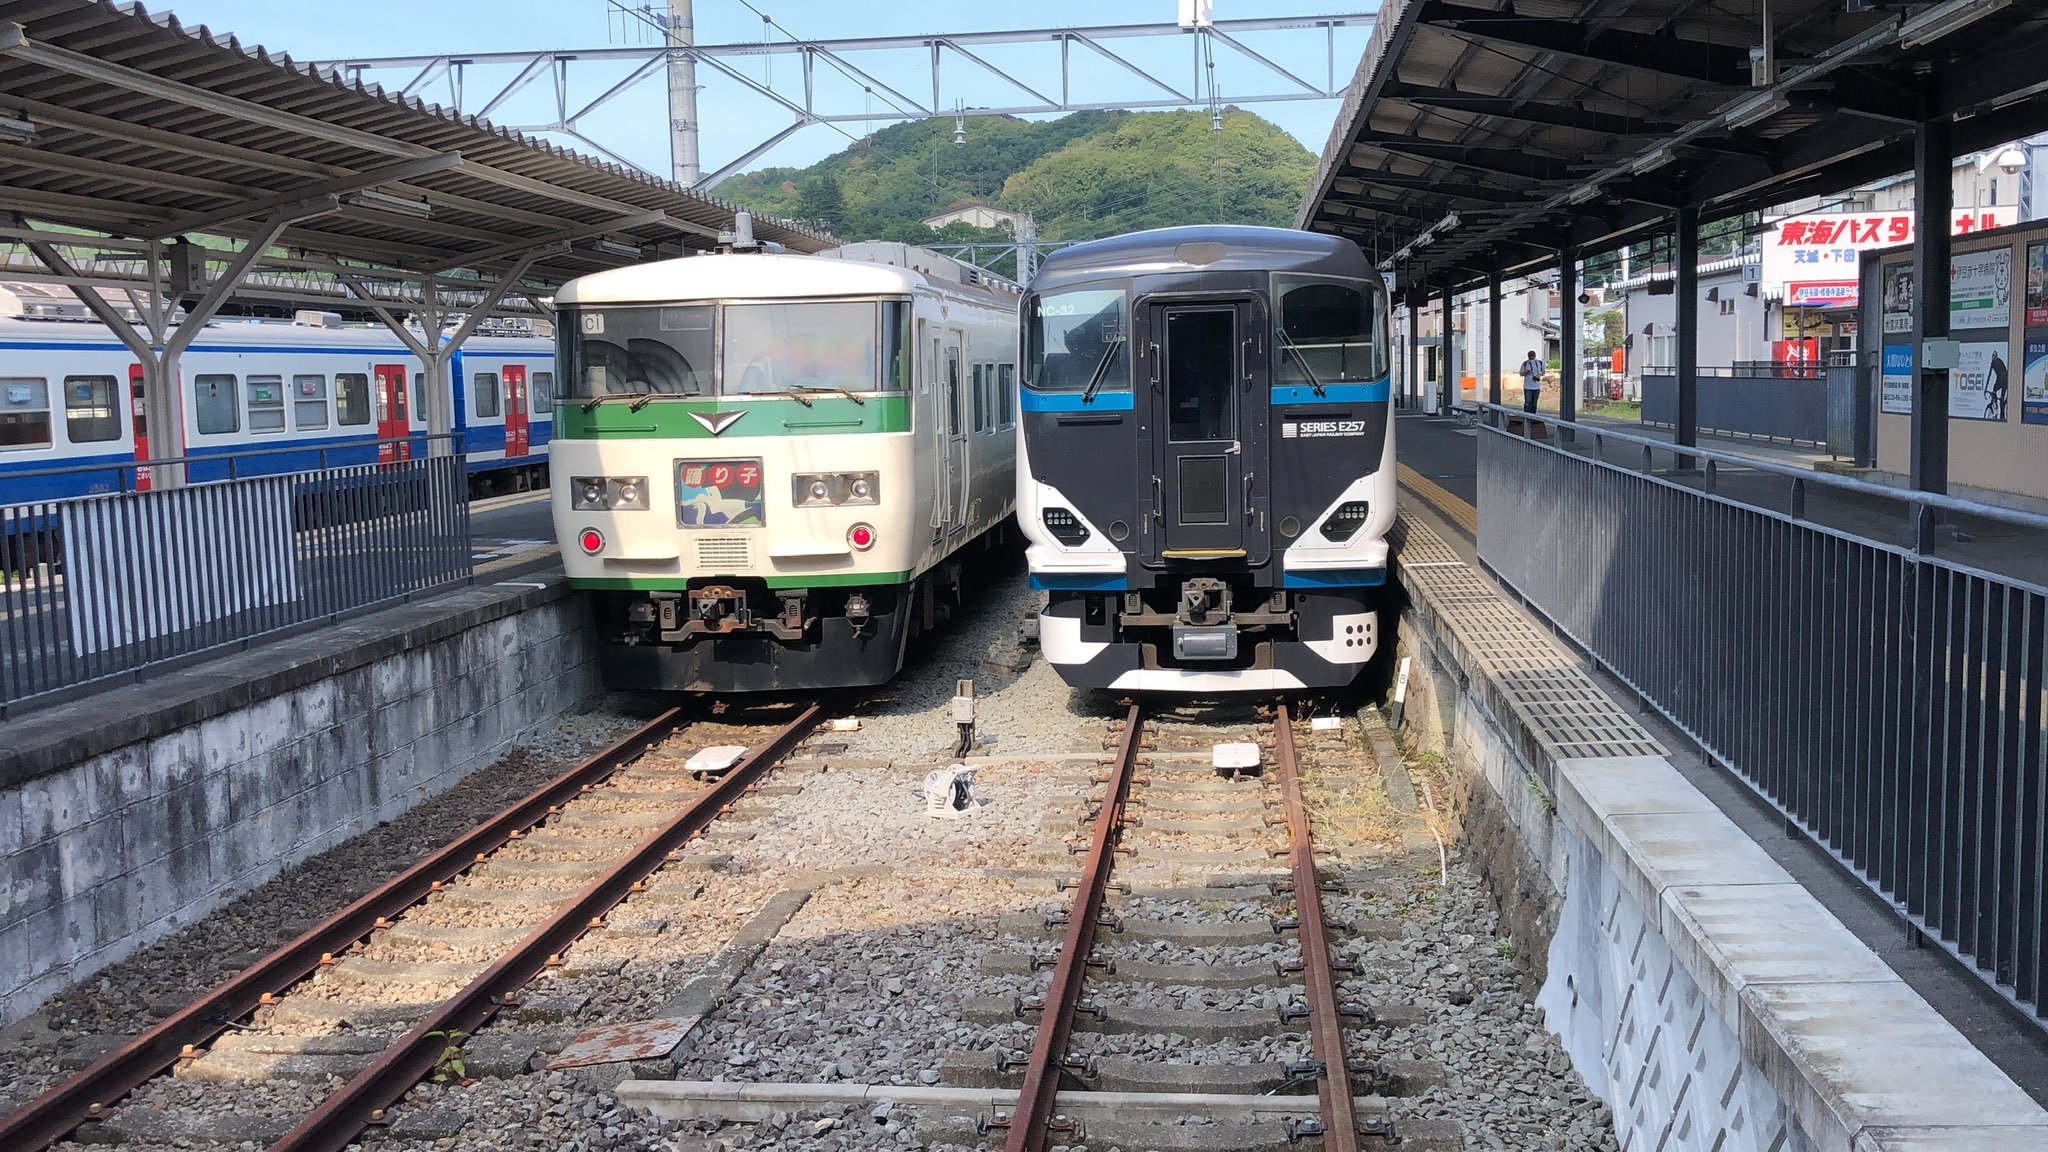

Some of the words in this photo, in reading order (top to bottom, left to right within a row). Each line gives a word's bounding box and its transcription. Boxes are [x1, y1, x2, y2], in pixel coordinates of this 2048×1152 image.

[1748, 267, 1756, 279] 1
[1037, 304, 1076, 317] NC-32
[1300, 422, 1338, 433] SERIES
[1338, 420, 1366, 432] E257
[684, 466, 758, 485] 踊り子
